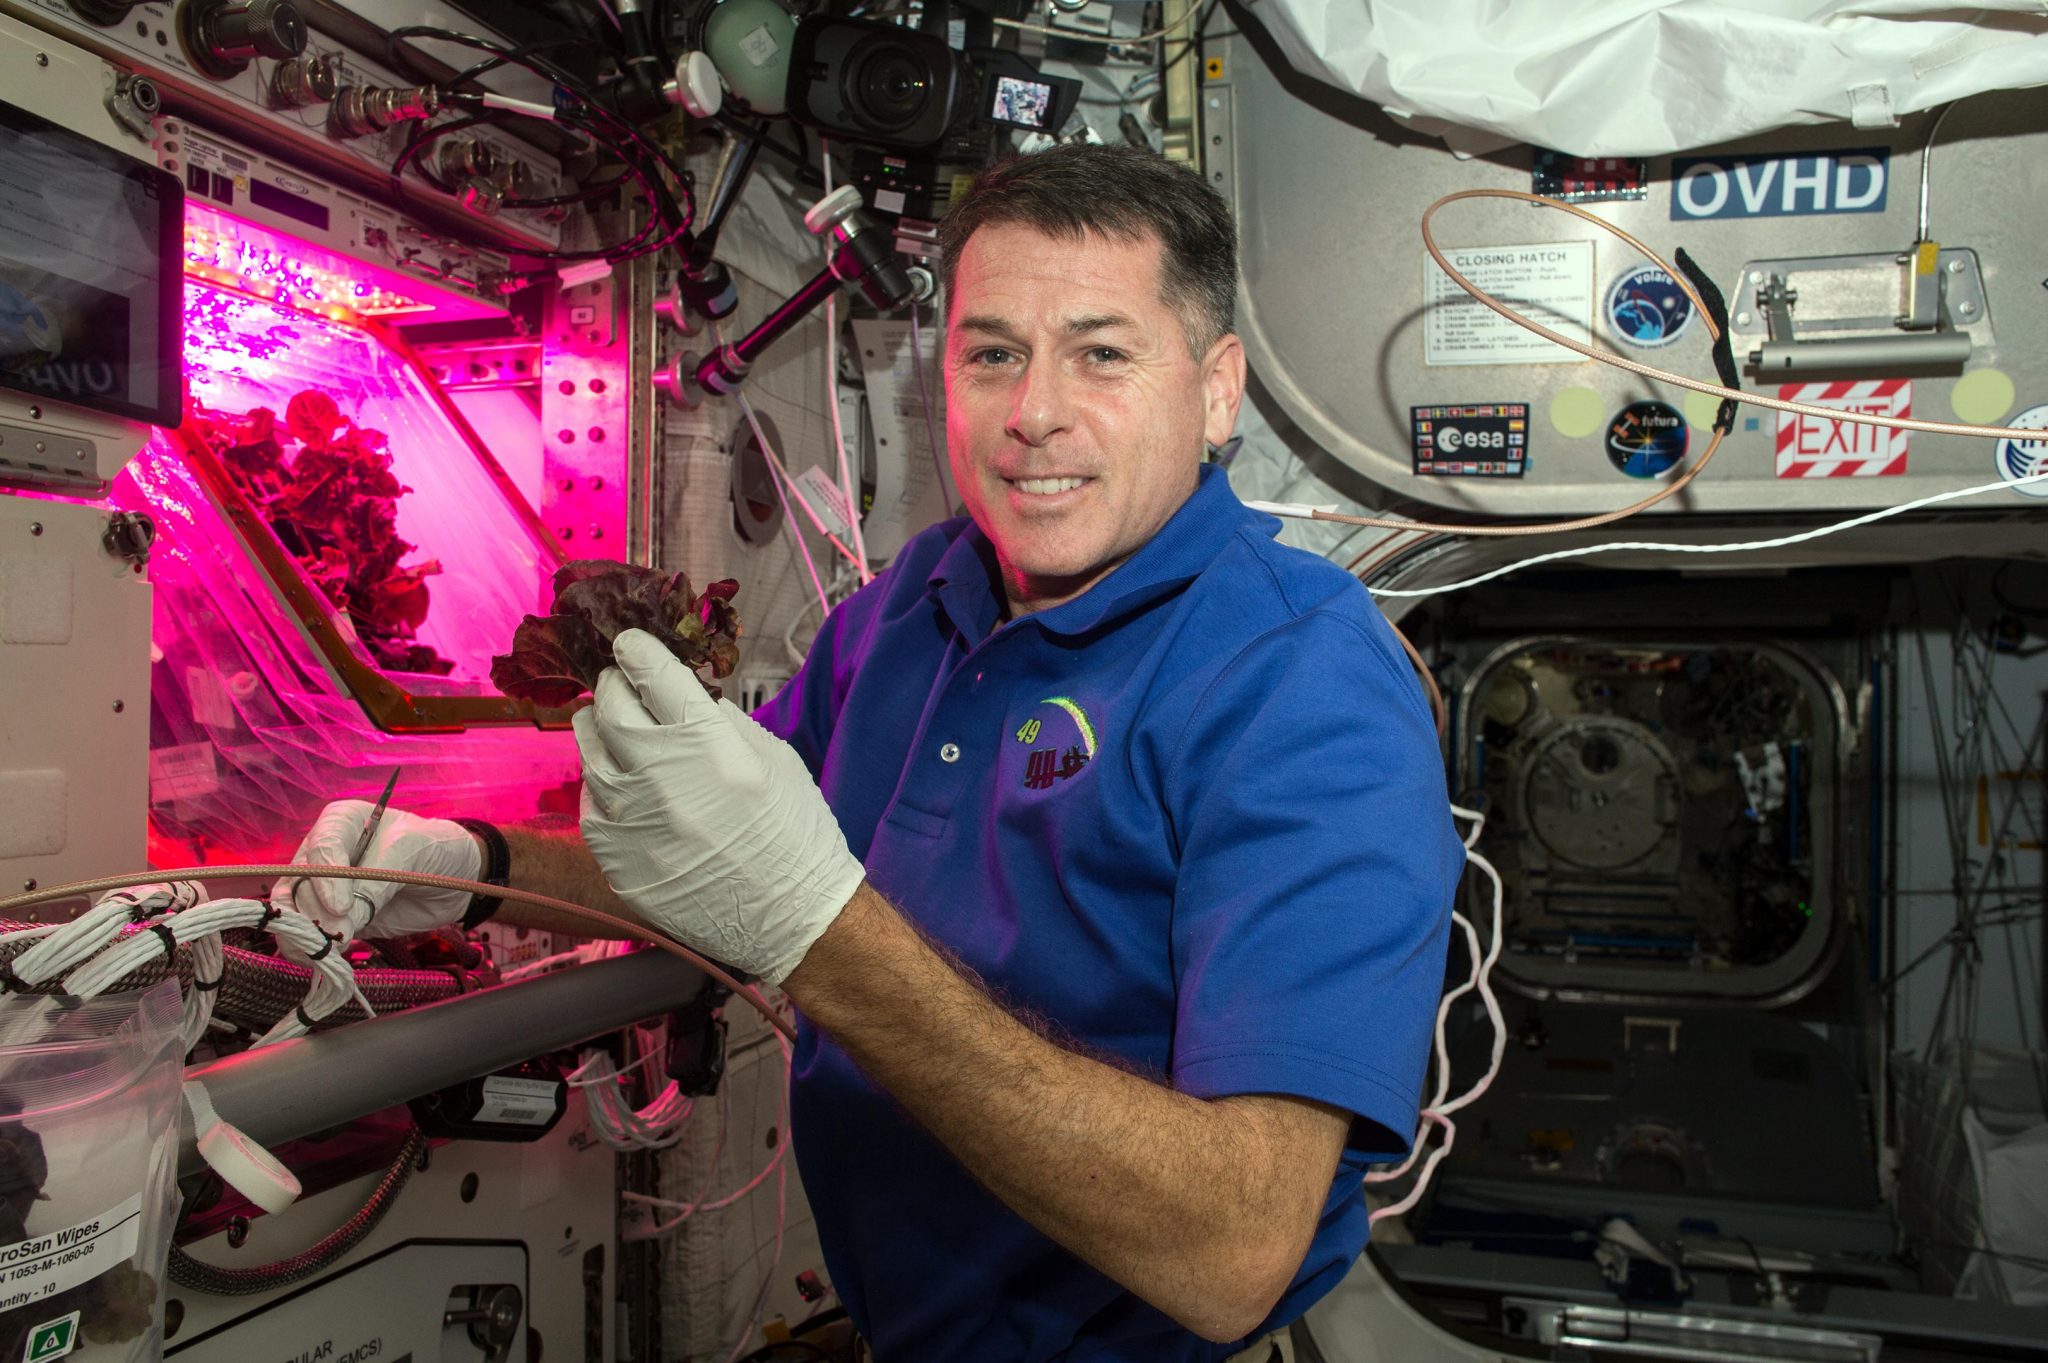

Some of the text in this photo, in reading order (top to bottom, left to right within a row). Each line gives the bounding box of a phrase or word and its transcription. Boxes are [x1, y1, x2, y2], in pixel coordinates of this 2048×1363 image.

[1678, 155, 1884, 217] OVHD
[1456, 252, 1566, 266] CLOSING HATCH
[1641, 415, 1678, 427] futura
[1798, 404, 1889, 455] EXIT
[1463, 430, 1504, 448] esa
[1016, 718, 1042, 744] 49
[0, 1221, 100, 1264] roSan Wipes
[10, 1242, 95, 1281] 1053-M-1060-05
[43, 1282, 56, 1295] 10
[286, 1340, 333, 1363] ULAR
